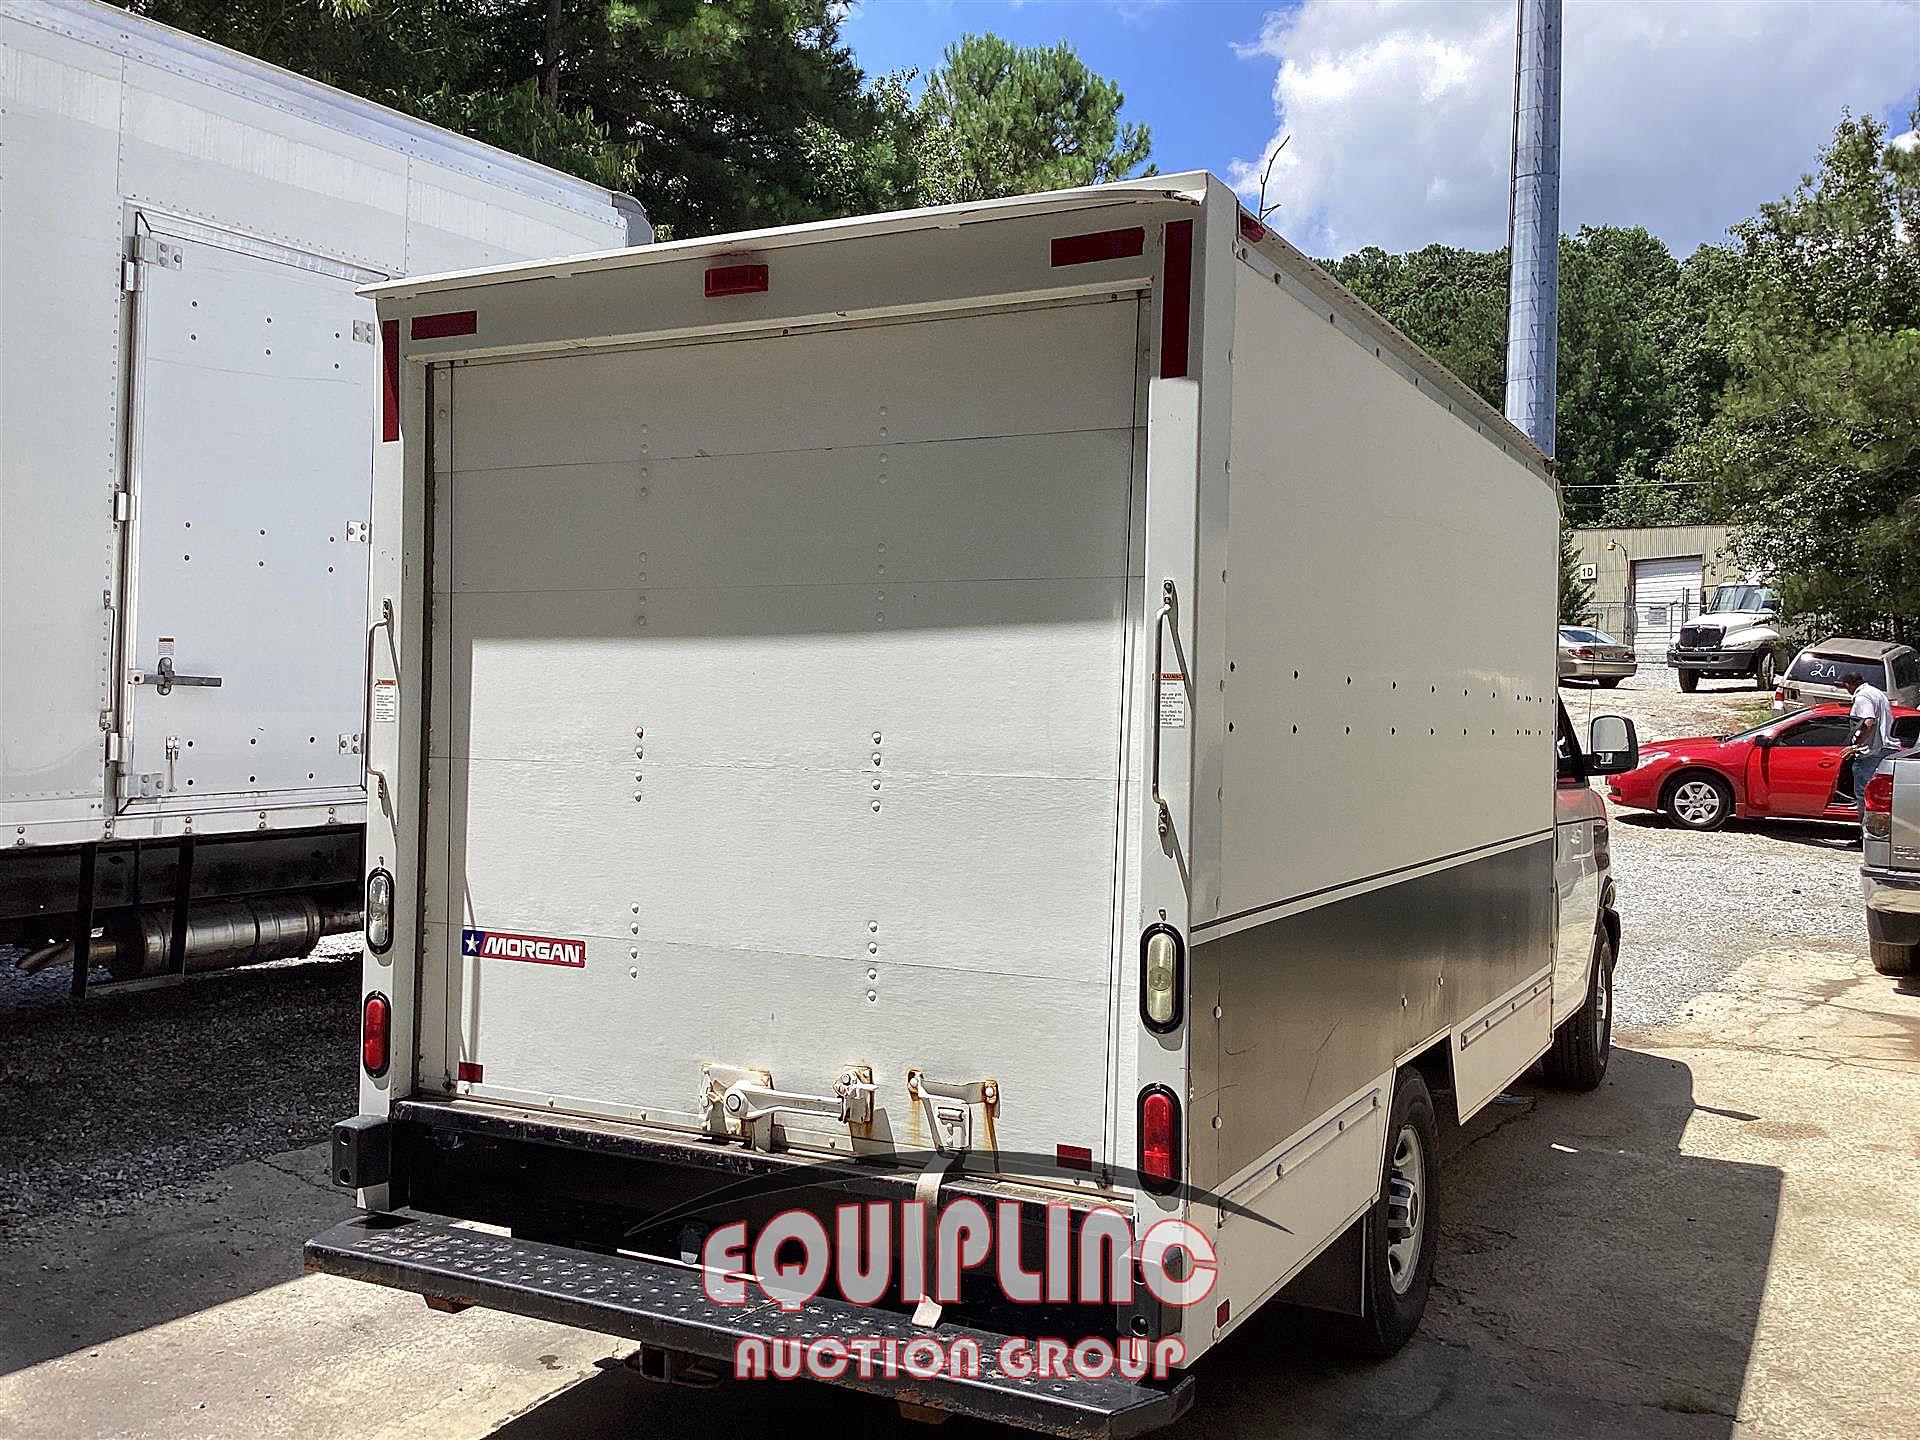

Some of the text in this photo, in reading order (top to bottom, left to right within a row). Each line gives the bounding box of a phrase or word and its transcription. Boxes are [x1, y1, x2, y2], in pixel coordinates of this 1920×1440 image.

[1582, 567, 1594, 577] 1D
[1810, 663, 1836, 678] 2A
[484, 936, 581, 963] MORGAN
